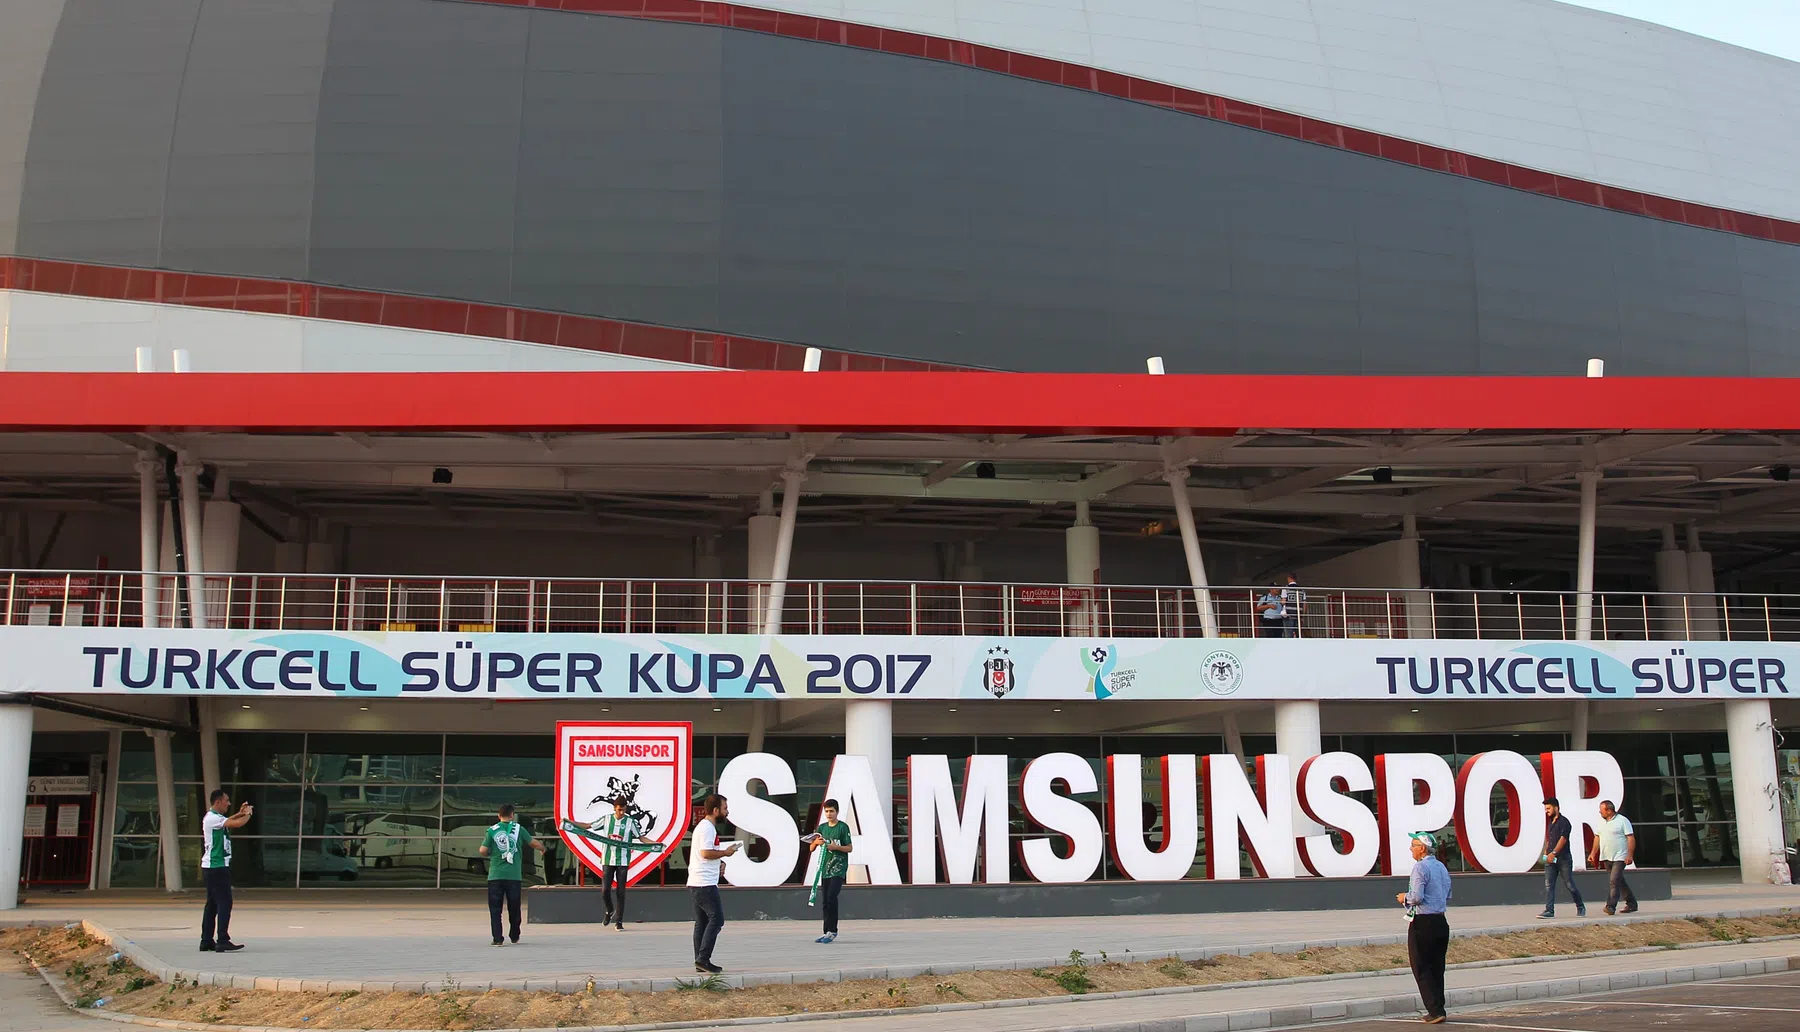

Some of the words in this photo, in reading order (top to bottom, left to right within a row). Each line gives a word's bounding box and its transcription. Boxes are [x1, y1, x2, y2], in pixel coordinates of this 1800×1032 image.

[83, 647, 377, 691] TURKCELL
[402, 642, 602, 693] SÜPER
[630, 654, 785, 693] KUPA
[807, 655, 931, 694] 2017
[1204, 652, 1240, 669] KONYASPOR
[1110, 668, 1138, 678] TURKCELL
[1376, 658, 1617, 694] TURKCELL
[1632, 649, 1789, 694] SÜPER
[1110, 674, 1136, 685] SÜPER
[1111, 681, 1132, 691] KUPA
[578, 744, 670, 757] SAMSUNSPOR
[717, 750, 1636, 887] SAMSUNSPOR
